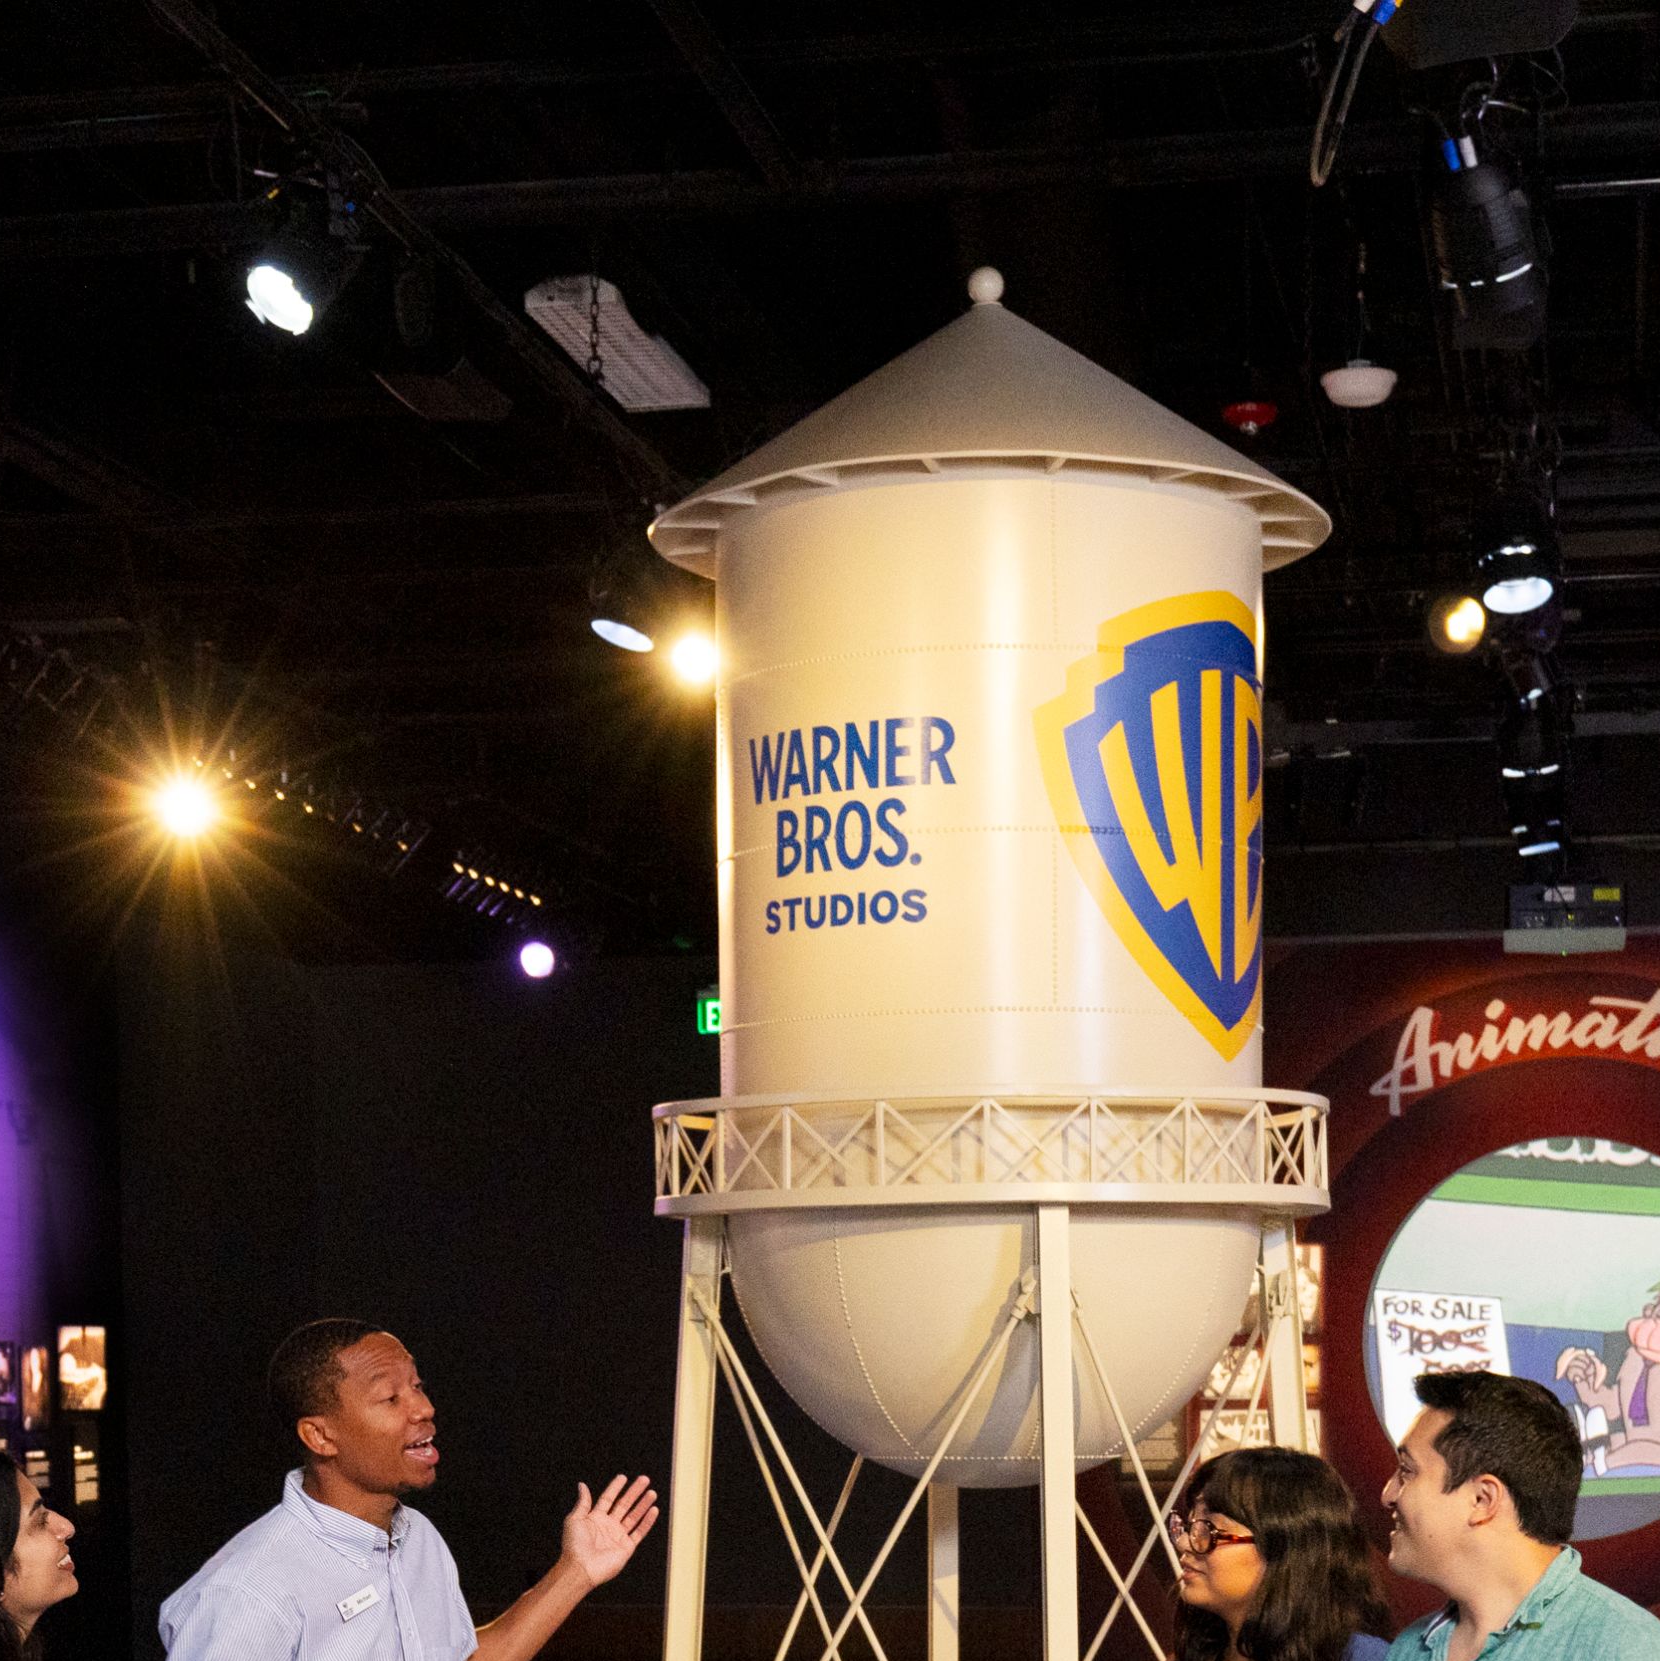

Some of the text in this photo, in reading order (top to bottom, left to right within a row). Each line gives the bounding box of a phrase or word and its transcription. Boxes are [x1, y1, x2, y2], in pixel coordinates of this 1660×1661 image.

[749, 716, 957, 805] WARNER
[775, 797, 922, 878] BROS.
[765, 889, 928, 935] STUDIOS
[1382, 1296, 1492, 1321] FOR SALE
